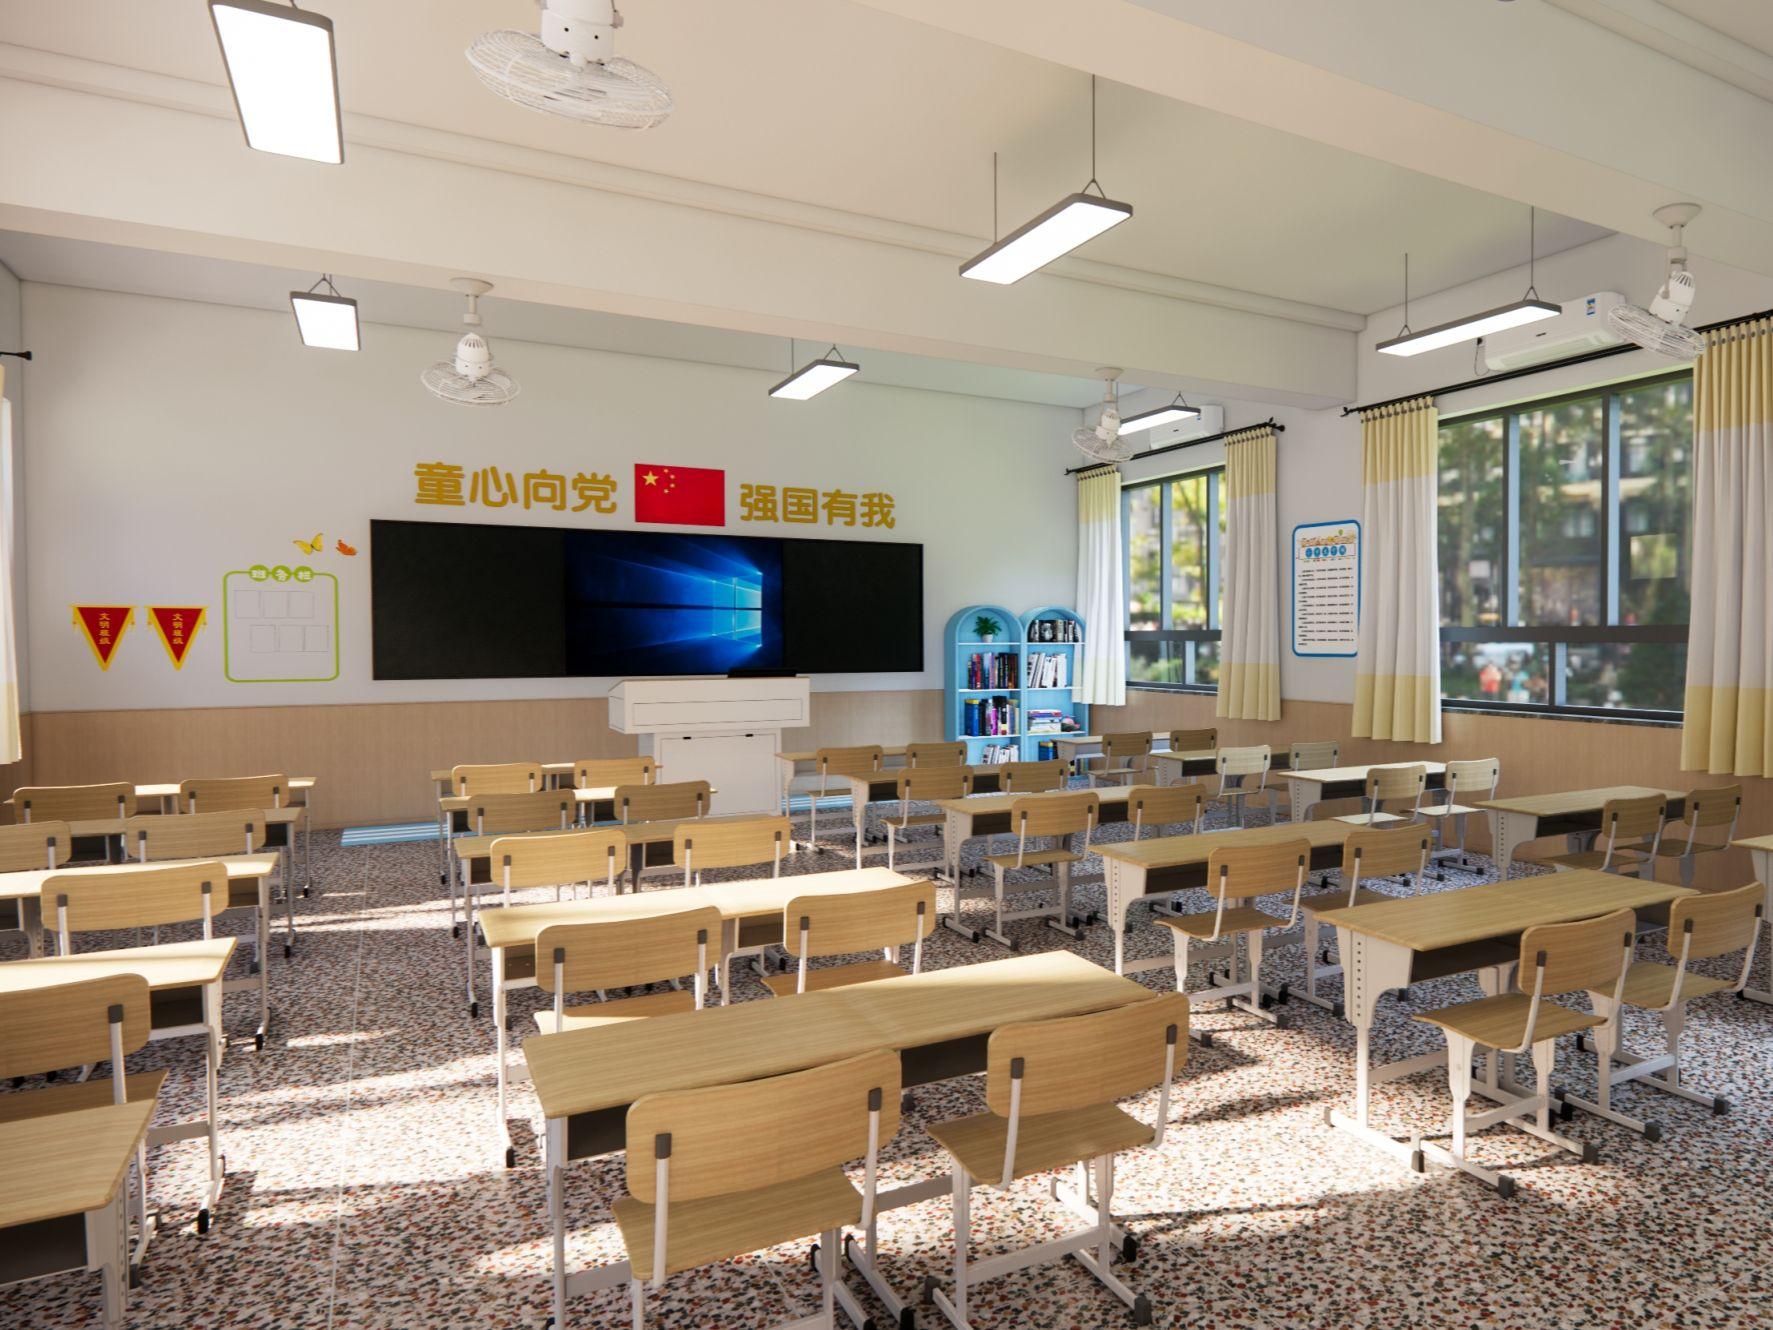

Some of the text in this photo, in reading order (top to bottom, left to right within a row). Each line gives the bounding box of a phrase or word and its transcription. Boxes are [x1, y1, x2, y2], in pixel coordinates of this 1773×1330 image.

[414, 461, 617, 514] 童心向党
[740, 483, 896, 529] 强国有我
